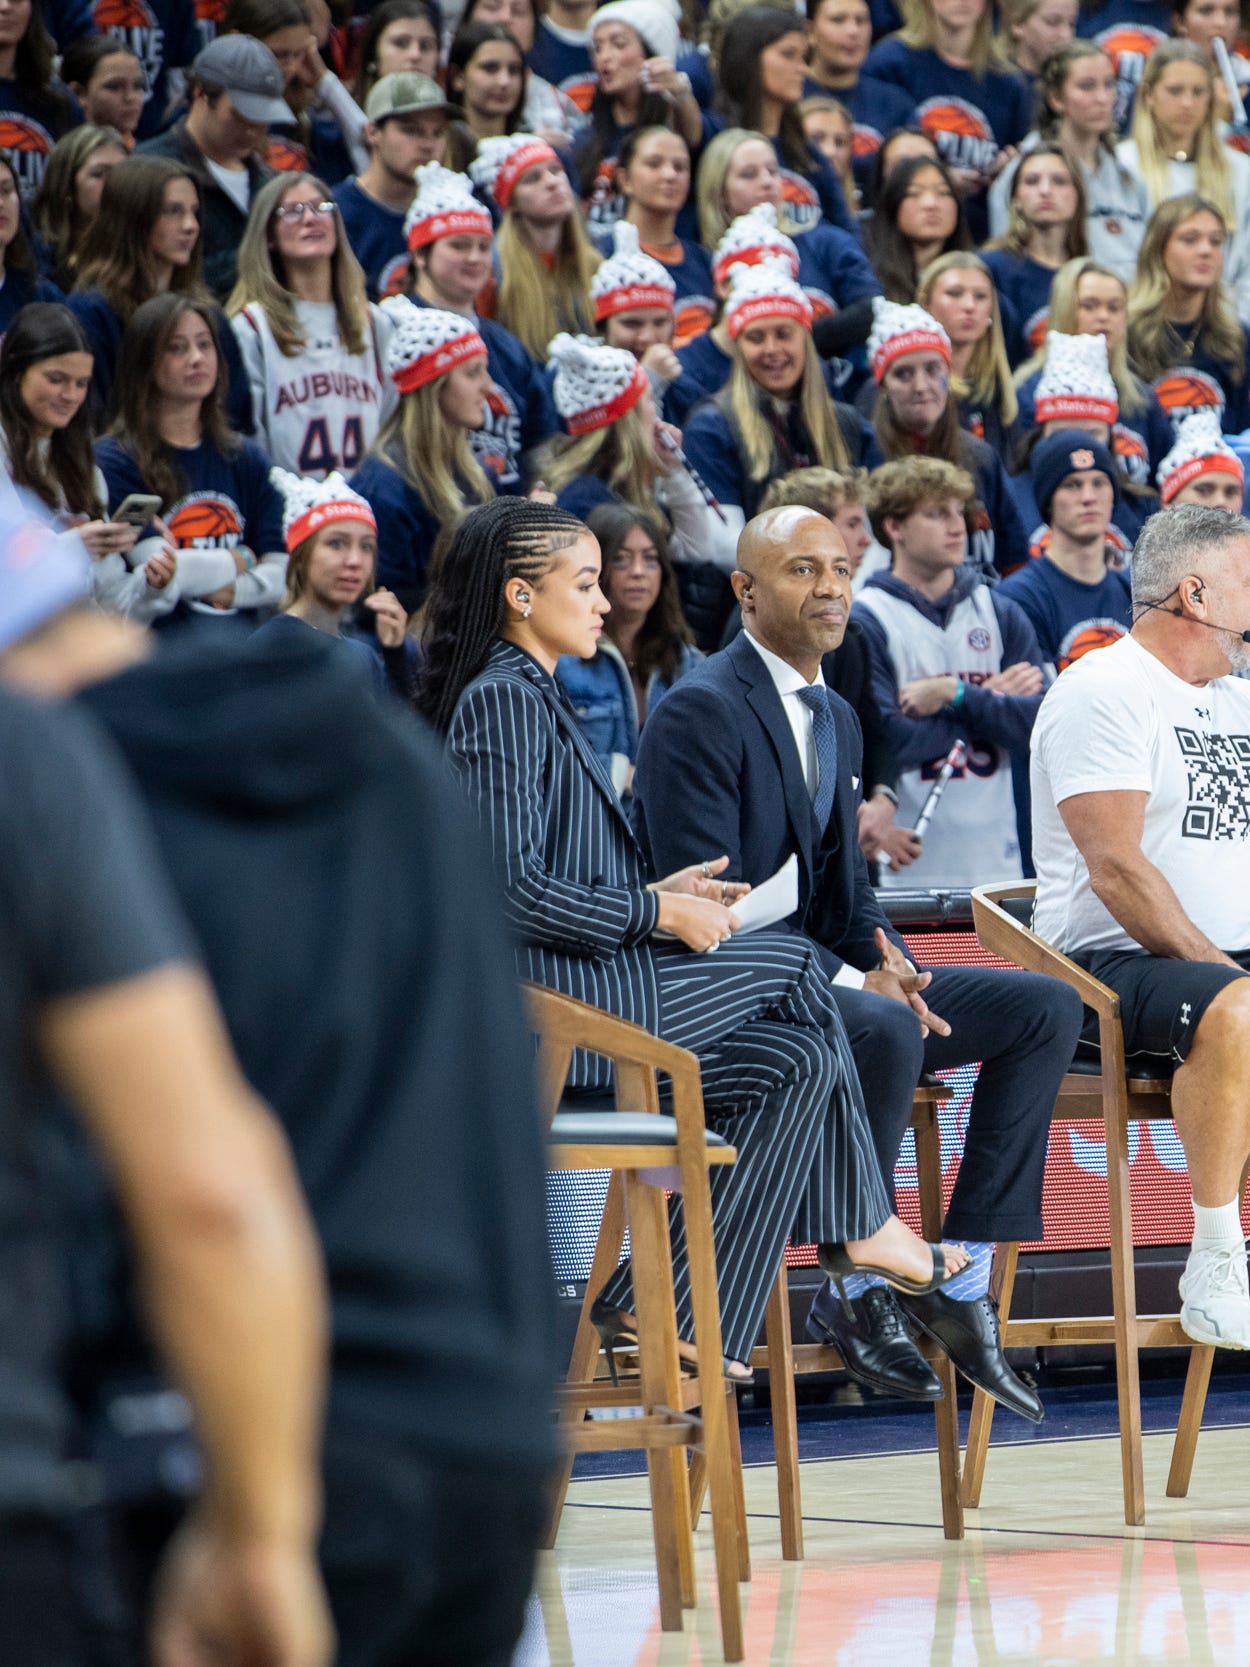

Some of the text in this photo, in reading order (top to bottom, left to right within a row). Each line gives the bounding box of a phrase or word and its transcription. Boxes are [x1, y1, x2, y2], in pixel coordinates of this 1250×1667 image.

[912, 331, 939, 345] Farm
[275, 371, 377, 416] AUBURN
[1056, 400, 1084, 411] State
[298, 414, 366, 480] 44
[325, 503, 359, 516] State
